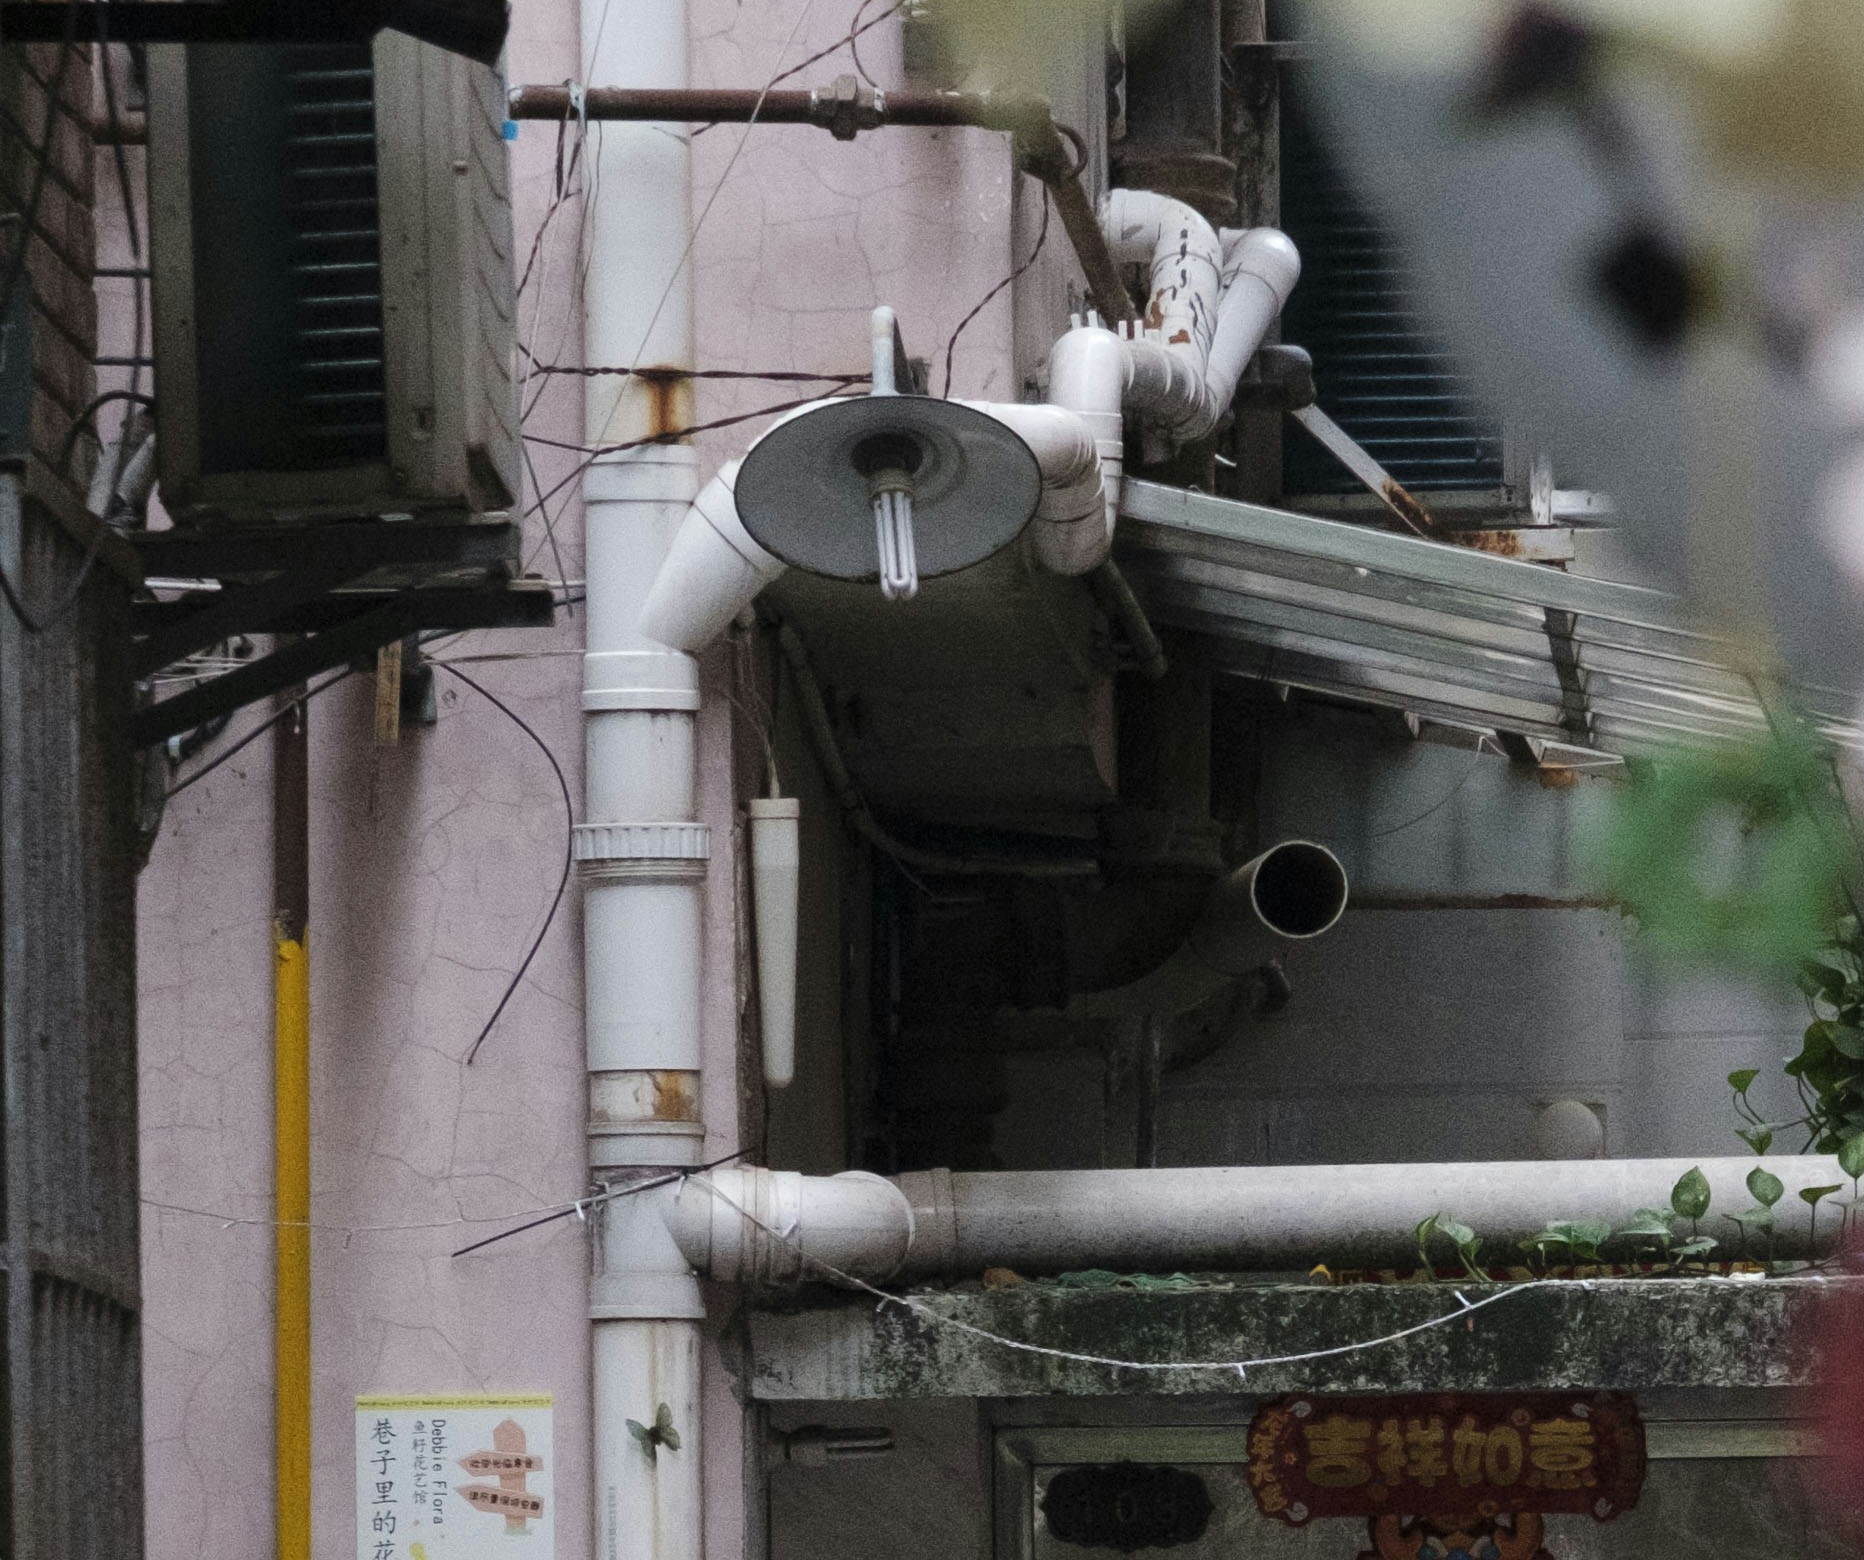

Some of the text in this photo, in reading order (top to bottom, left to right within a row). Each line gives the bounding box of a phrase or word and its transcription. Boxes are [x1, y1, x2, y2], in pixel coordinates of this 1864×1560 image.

[431, 1419, 448, 1524] Debbie Flora
[1302, 1415, 1598, 1489] 吉祥如意
